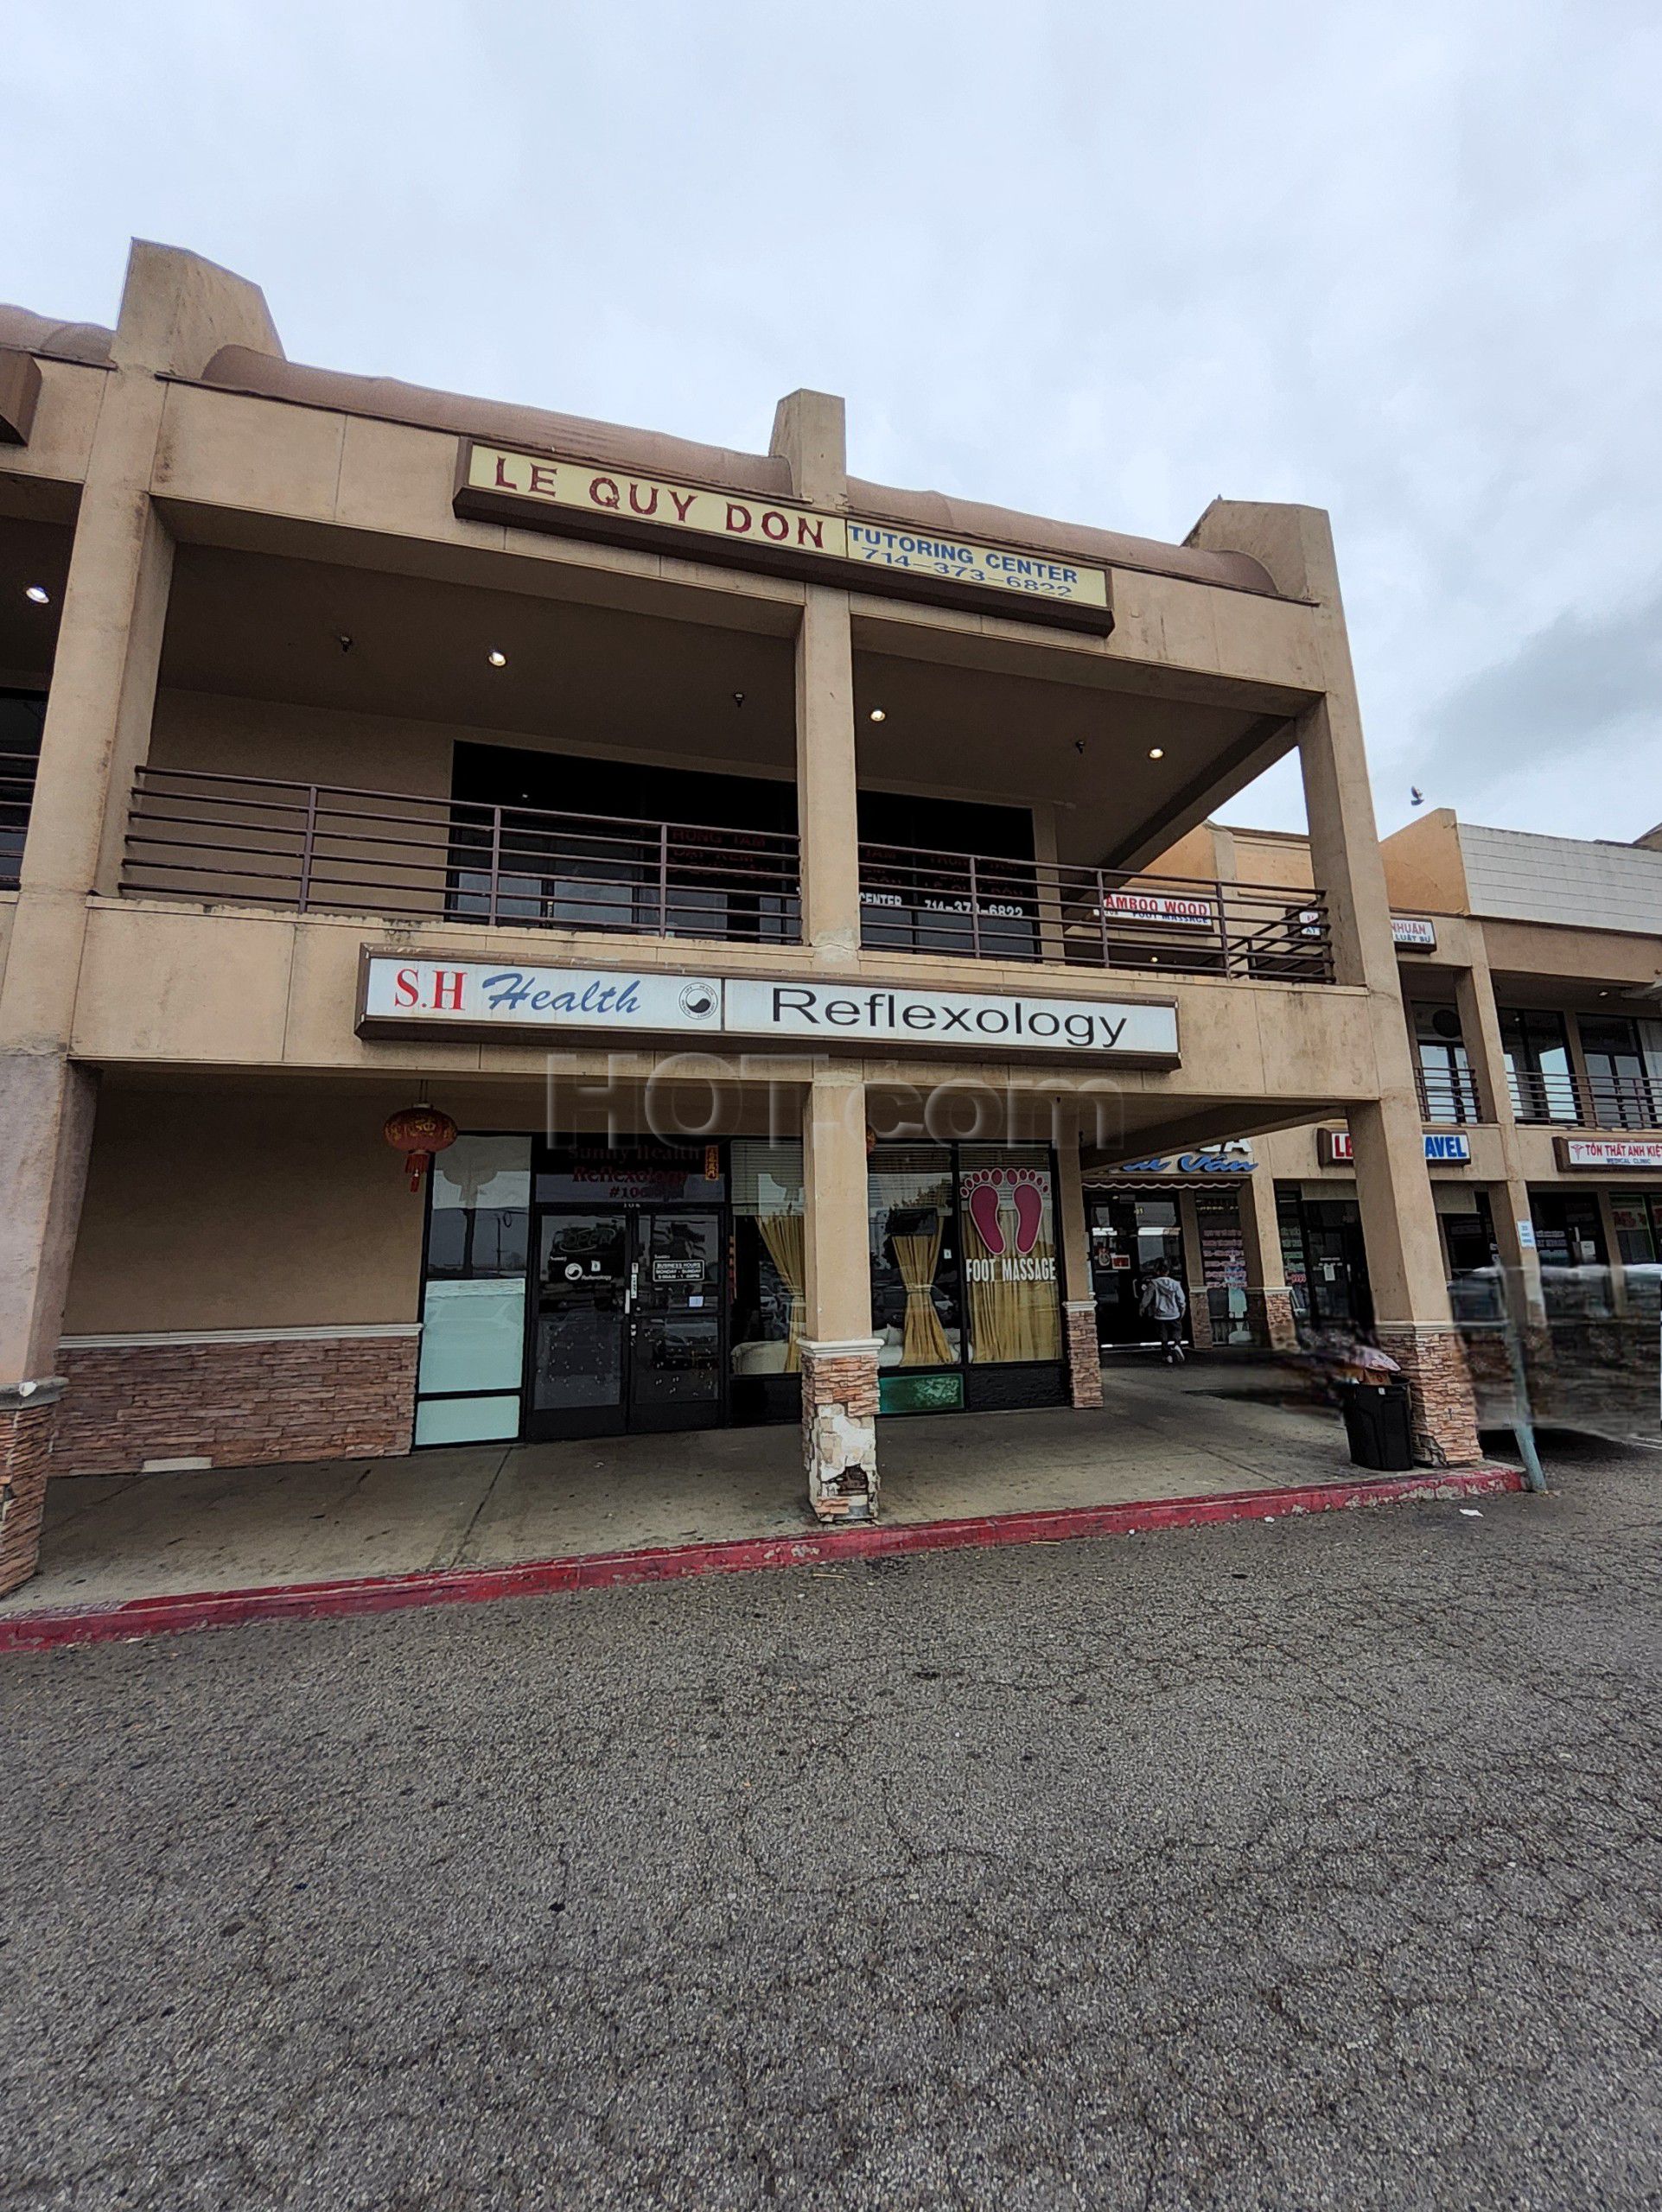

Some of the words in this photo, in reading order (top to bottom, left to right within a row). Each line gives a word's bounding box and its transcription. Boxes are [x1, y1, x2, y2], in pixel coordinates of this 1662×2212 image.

[494, 455, 557, 497] LE
[589, 476, 698, 523] QUY
[725, 501, 824, 550] DON
[848, 524, 974, 565] TUTORING
[985, 553, 1078, 584] CENTER
[861, 546, 1073, 599] 714-373-6822
[1163, 900, 1207, 917] WOOD
[394, 969, 468, 1010] S.H
[481, 972, 641, 1014] Health
[772, 988, 1127, 1048] Reflexology
[1424, 1136, 1467, 1158] AVEL
[1627, 1145, 1645, 1156] ANH
[965, 1259, 995, 1282] FOOT
[1002, 1257, 1057, 1281] MASSAGE
